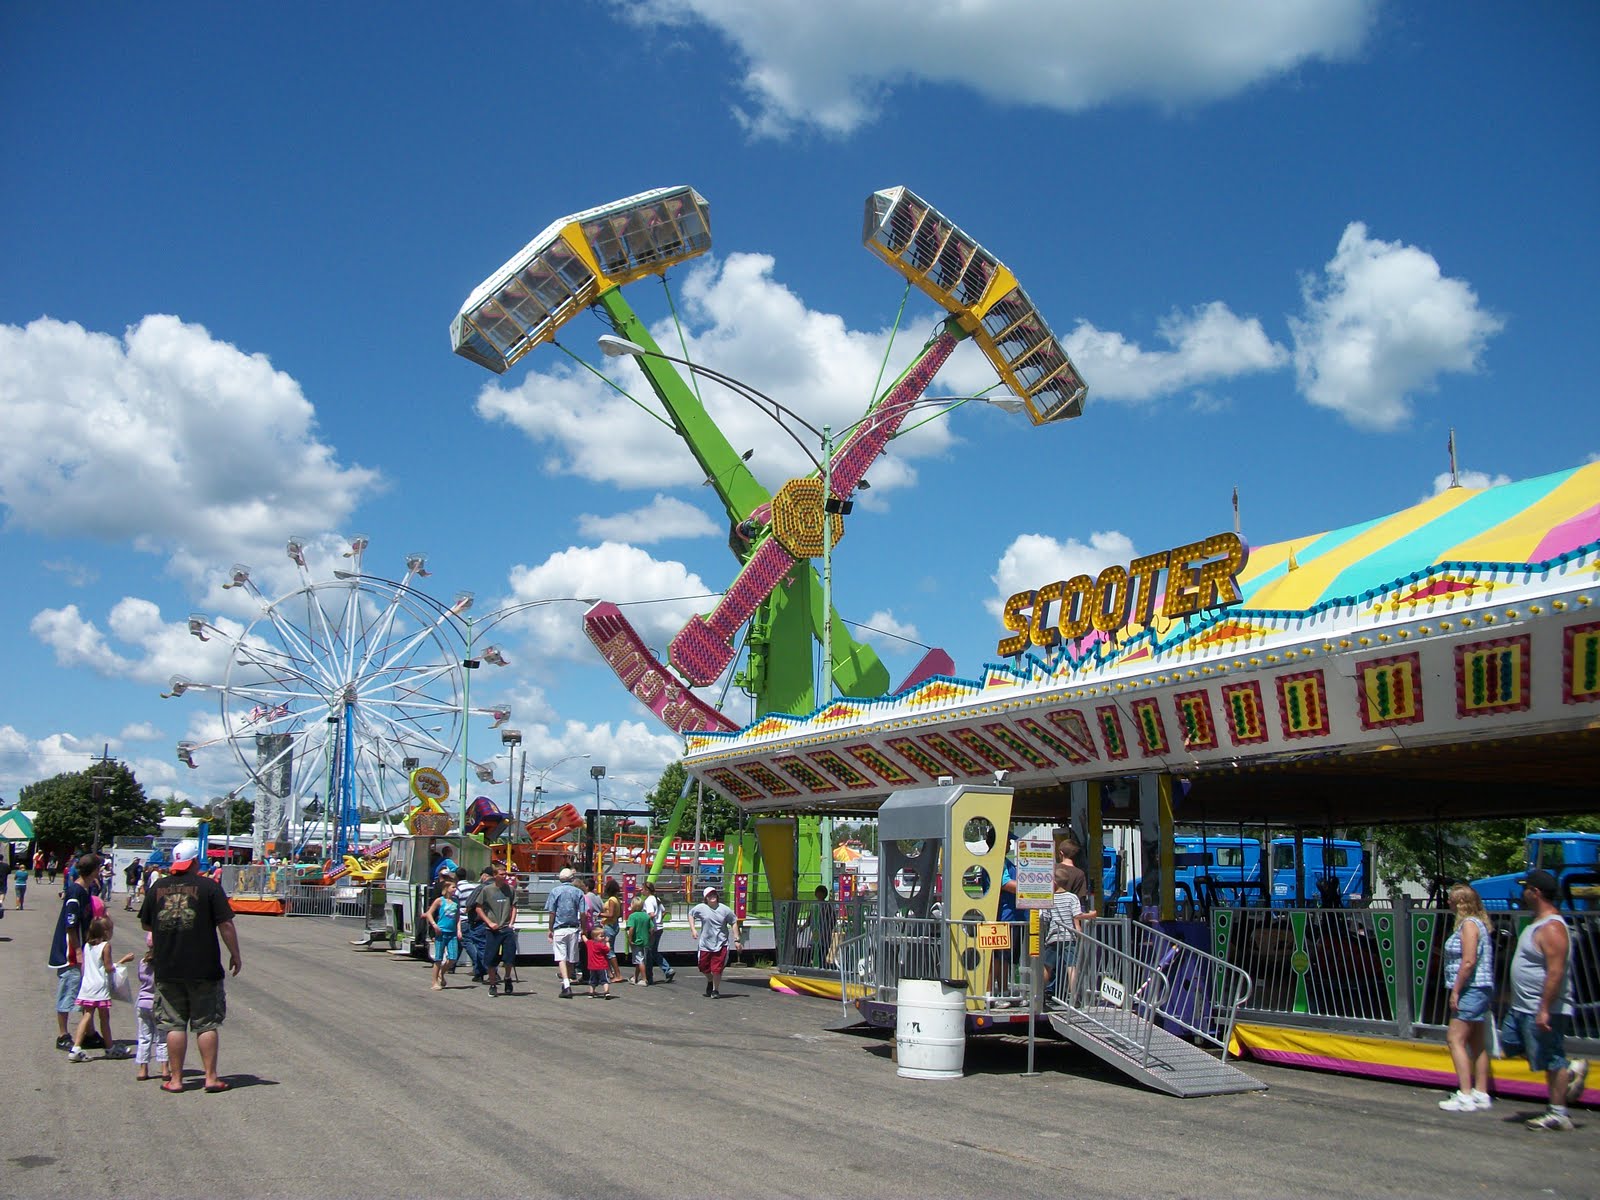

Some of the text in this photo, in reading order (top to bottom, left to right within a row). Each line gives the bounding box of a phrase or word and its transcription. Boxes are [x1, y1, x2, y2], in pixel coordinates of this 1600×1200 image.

[997, 532, 1250, 658] SCOOTER
[596, 629, 666, 703] GUN
[991, 926, 998, 935] 3
[981, 935, 1008, 946] TICKETS
[1102, 982, 1123, 1001] ENTER
